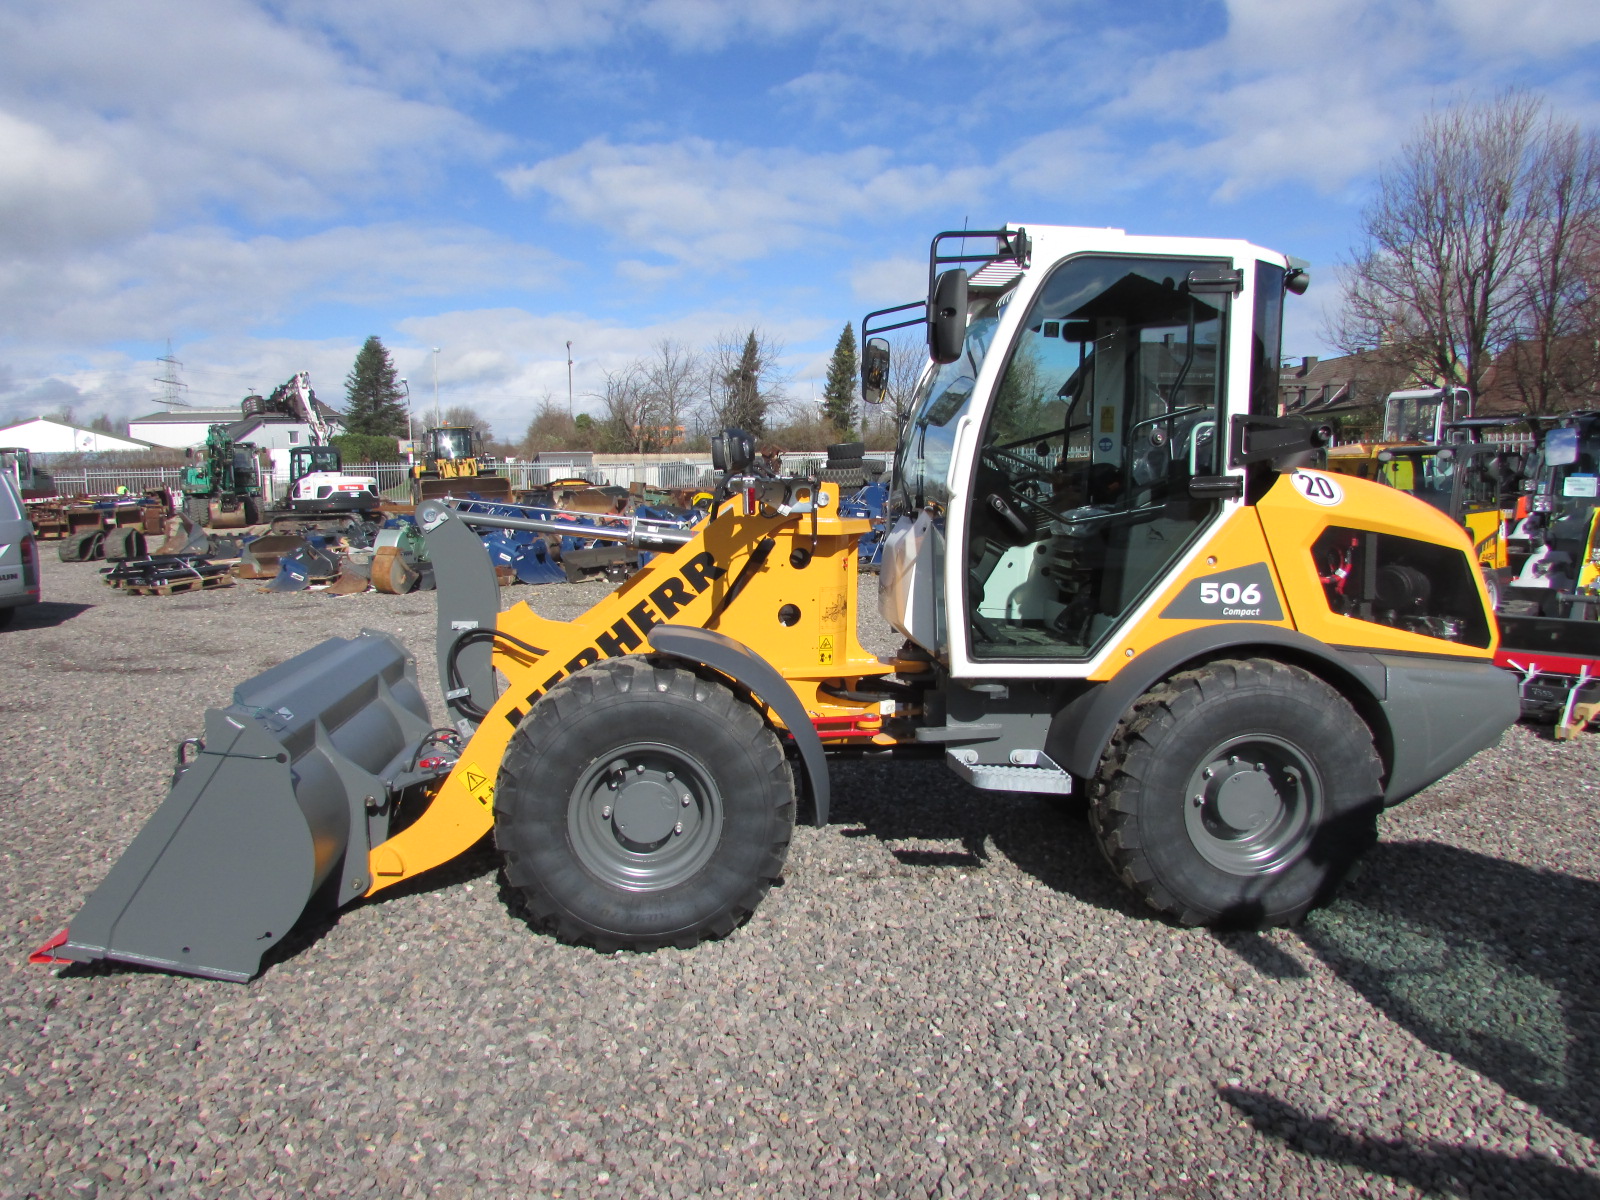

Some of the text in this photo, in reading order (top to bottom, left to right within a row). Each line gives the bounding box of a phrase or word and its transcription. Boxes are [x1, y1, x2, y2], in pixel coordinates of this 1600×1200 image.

[1298, 474, 1334, 499] 20
[1200, 582, 1261, 605] 506
[1222, 607, 1260, 617] Compact
[504, 551, 728, 729] BHERR
